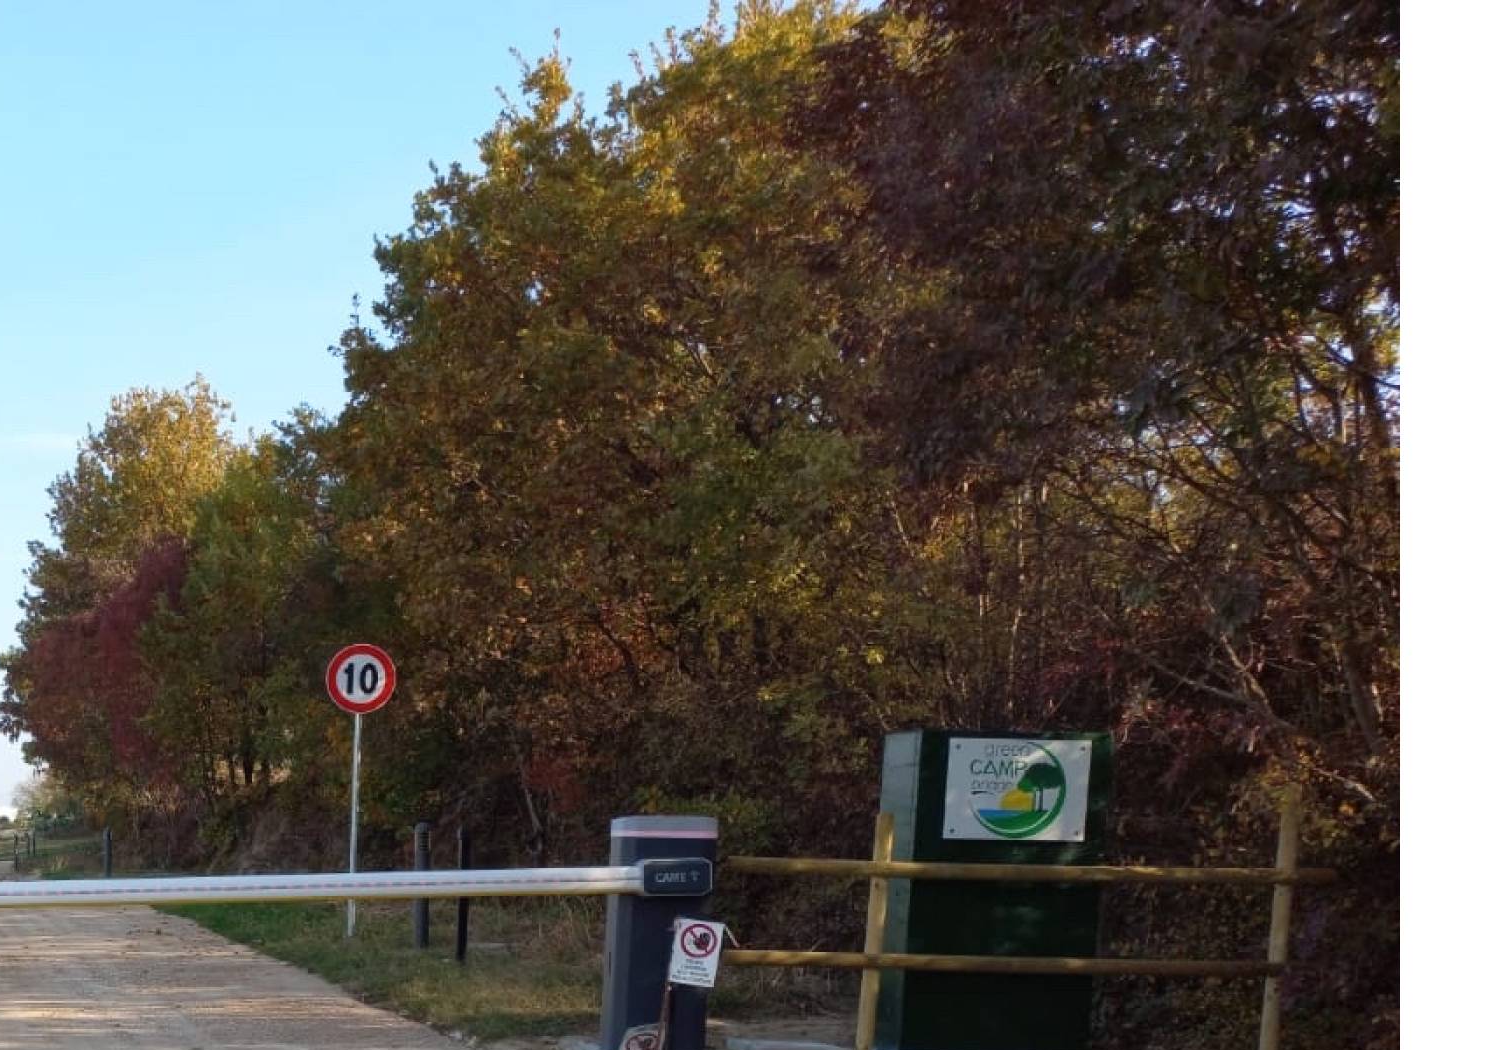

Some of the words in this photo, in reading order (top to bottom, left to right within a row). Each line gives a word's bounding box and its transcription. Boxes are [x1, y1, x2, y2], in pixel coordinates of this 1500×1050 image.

[344, 662, 379, 695] 10
[970, 759, 1027, 777] CAMP
[655, 871, 687, 883] CAME
